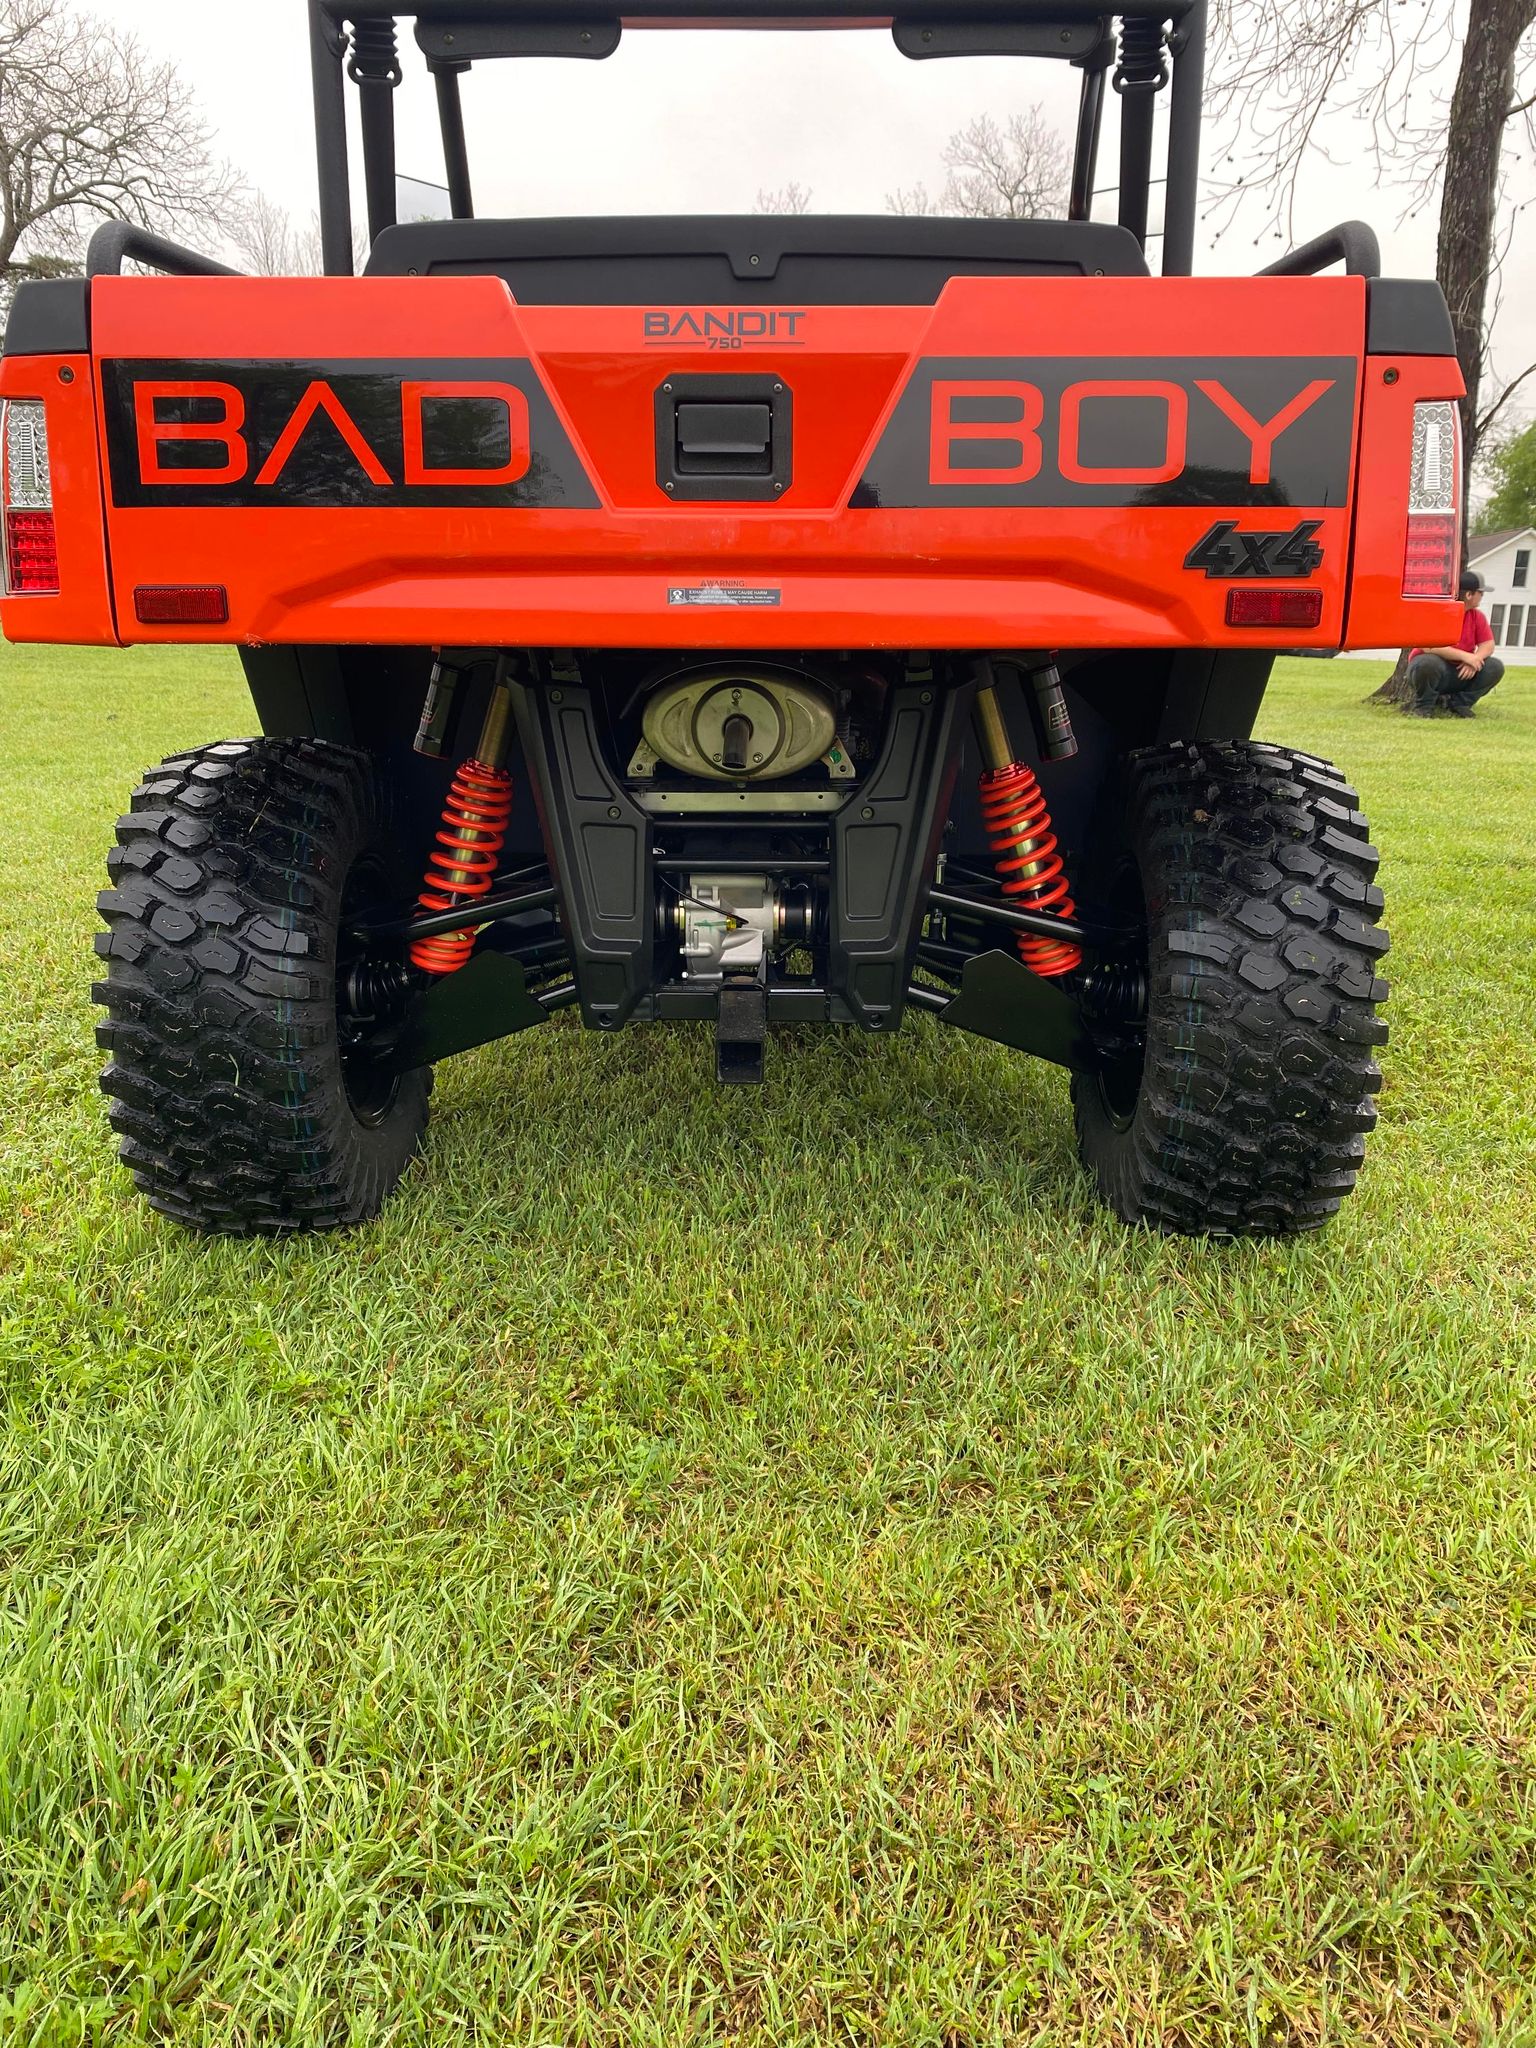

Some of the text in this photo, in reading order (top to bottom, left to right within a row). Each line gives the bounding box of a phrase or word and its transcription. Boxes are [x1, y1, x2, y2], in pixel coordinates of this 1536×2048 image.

[644, 312, 806, 336] BANDIT
[707, 337, 742, 349] 750
[133, 380, 1336, 486] BAD BOY
